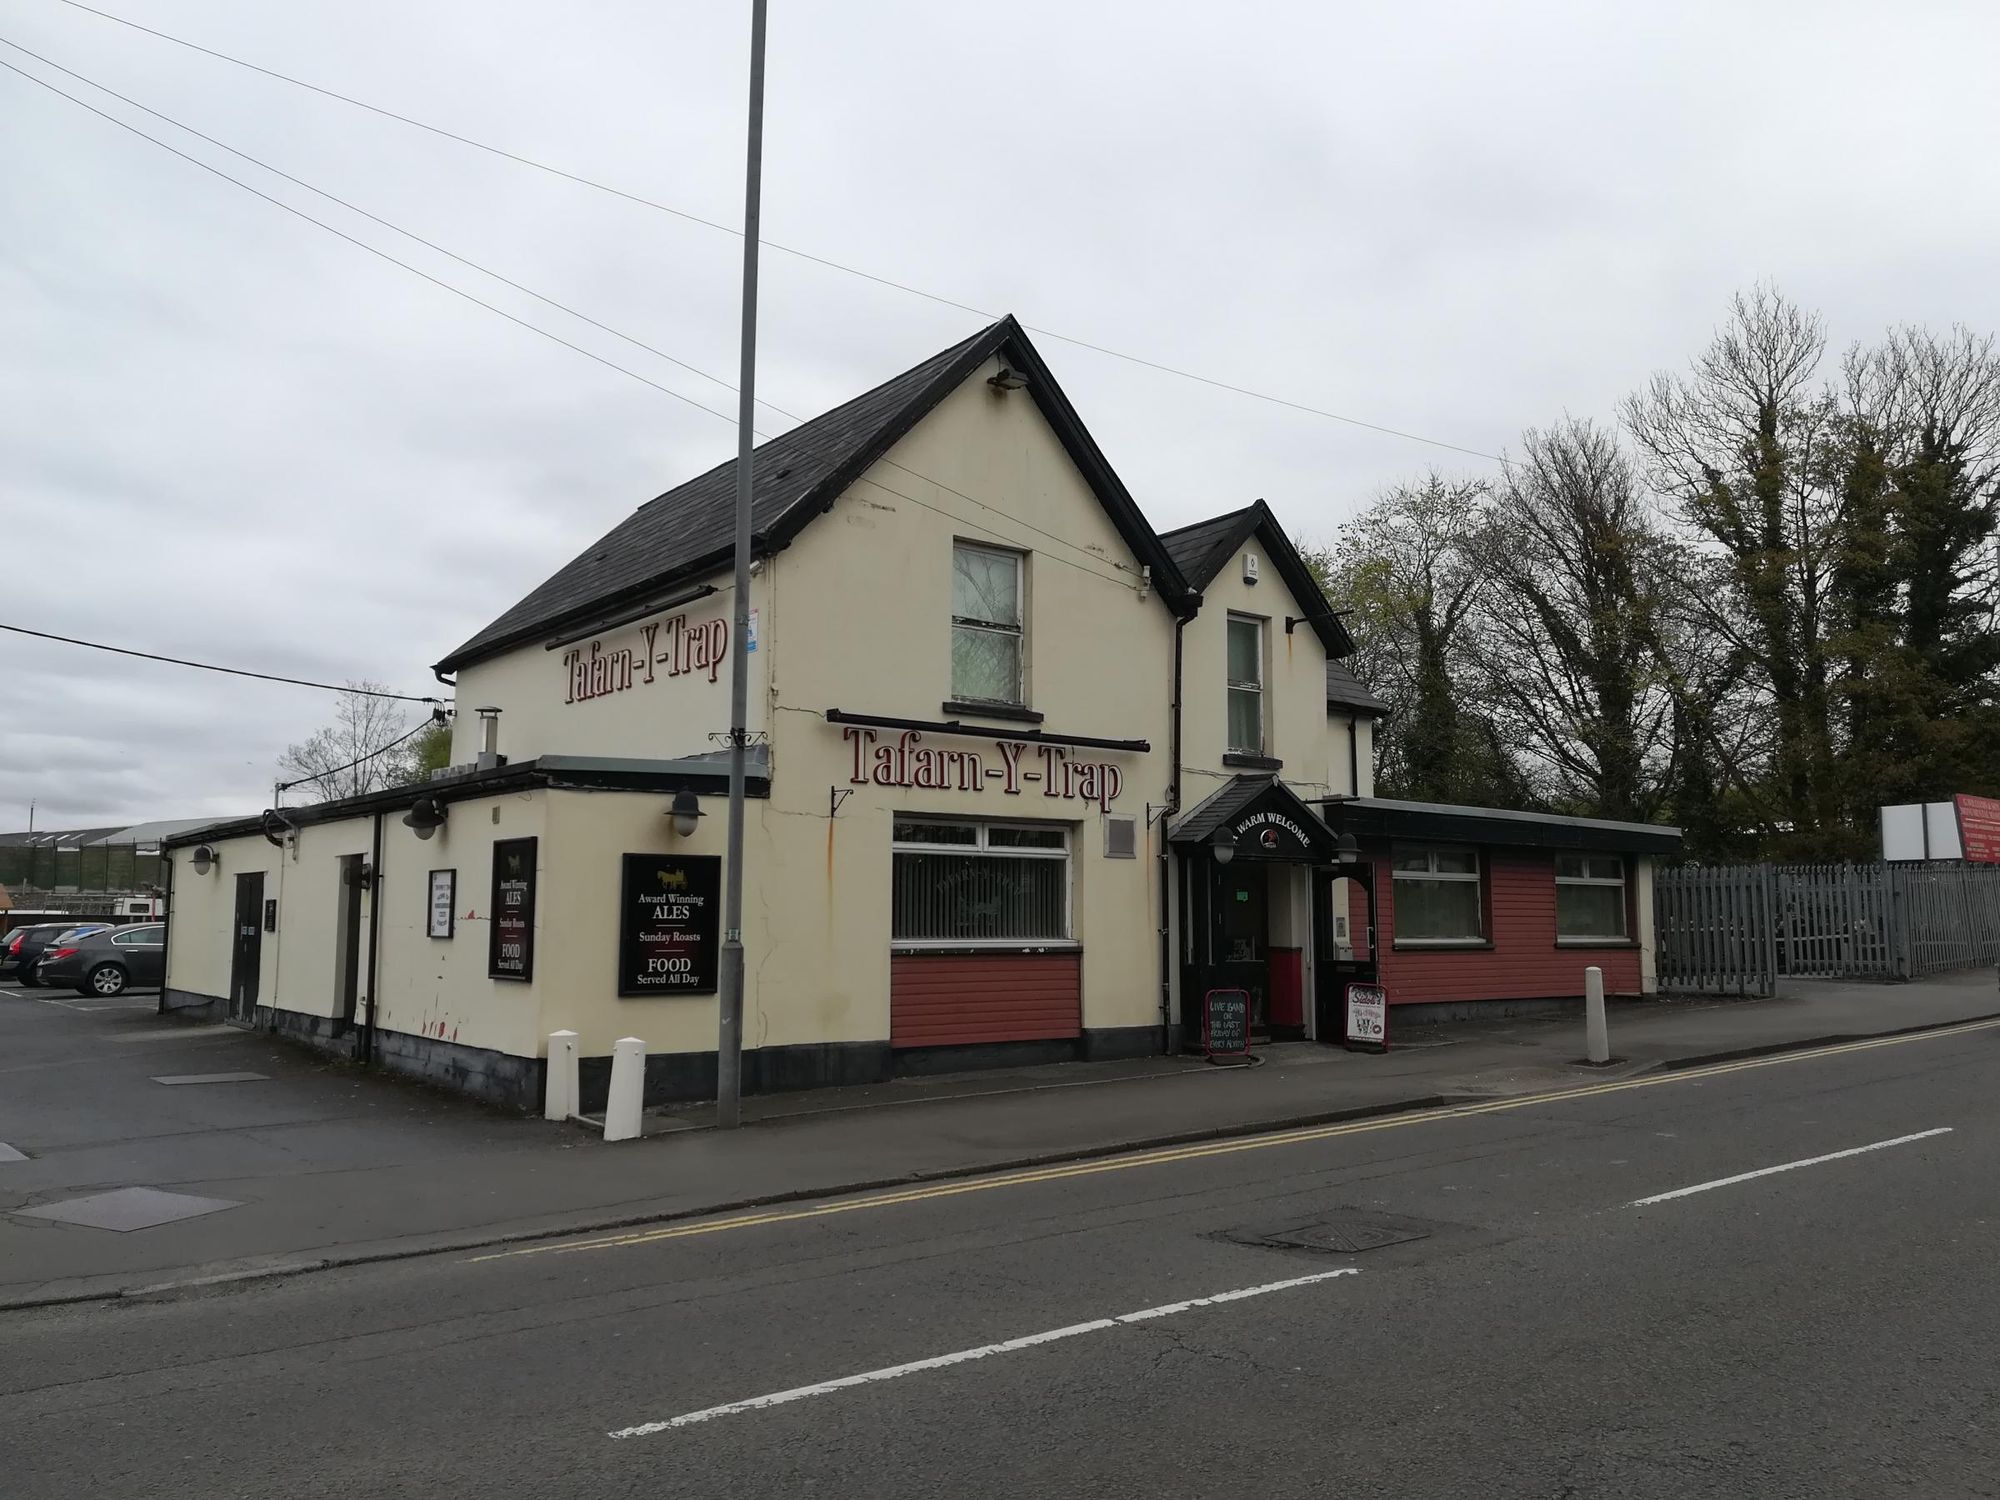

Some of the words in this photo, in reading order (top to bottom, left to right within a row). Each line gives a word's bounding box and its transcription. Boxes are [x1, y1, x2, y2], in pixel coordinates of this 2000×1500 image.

[563, 614, 728, 705] Tafarn-Y-Trap
[843, 726, 1123, 813] Tafarn-Y-Trap
[1237, 813, 1266, 834] WARM
[1267, 812, 1311, 848] WELCOME
[638, 893, 666, 904] Award
[668, 894, 704, 907] Winning
[653, 905, 690, 919] ALES
[639, 931, 671, 945] Sunday
[673, 932, 701, 942] Roasts
[502, 943, 520, 958] FOOD
[647, 958, 692, 972] FOOD
[637, 974, 666, 984] Served
[668, 974, 680, 984] All
[682, 974, 700, 986] Day
[1209, 1001, 1225, 1012] LIVE
